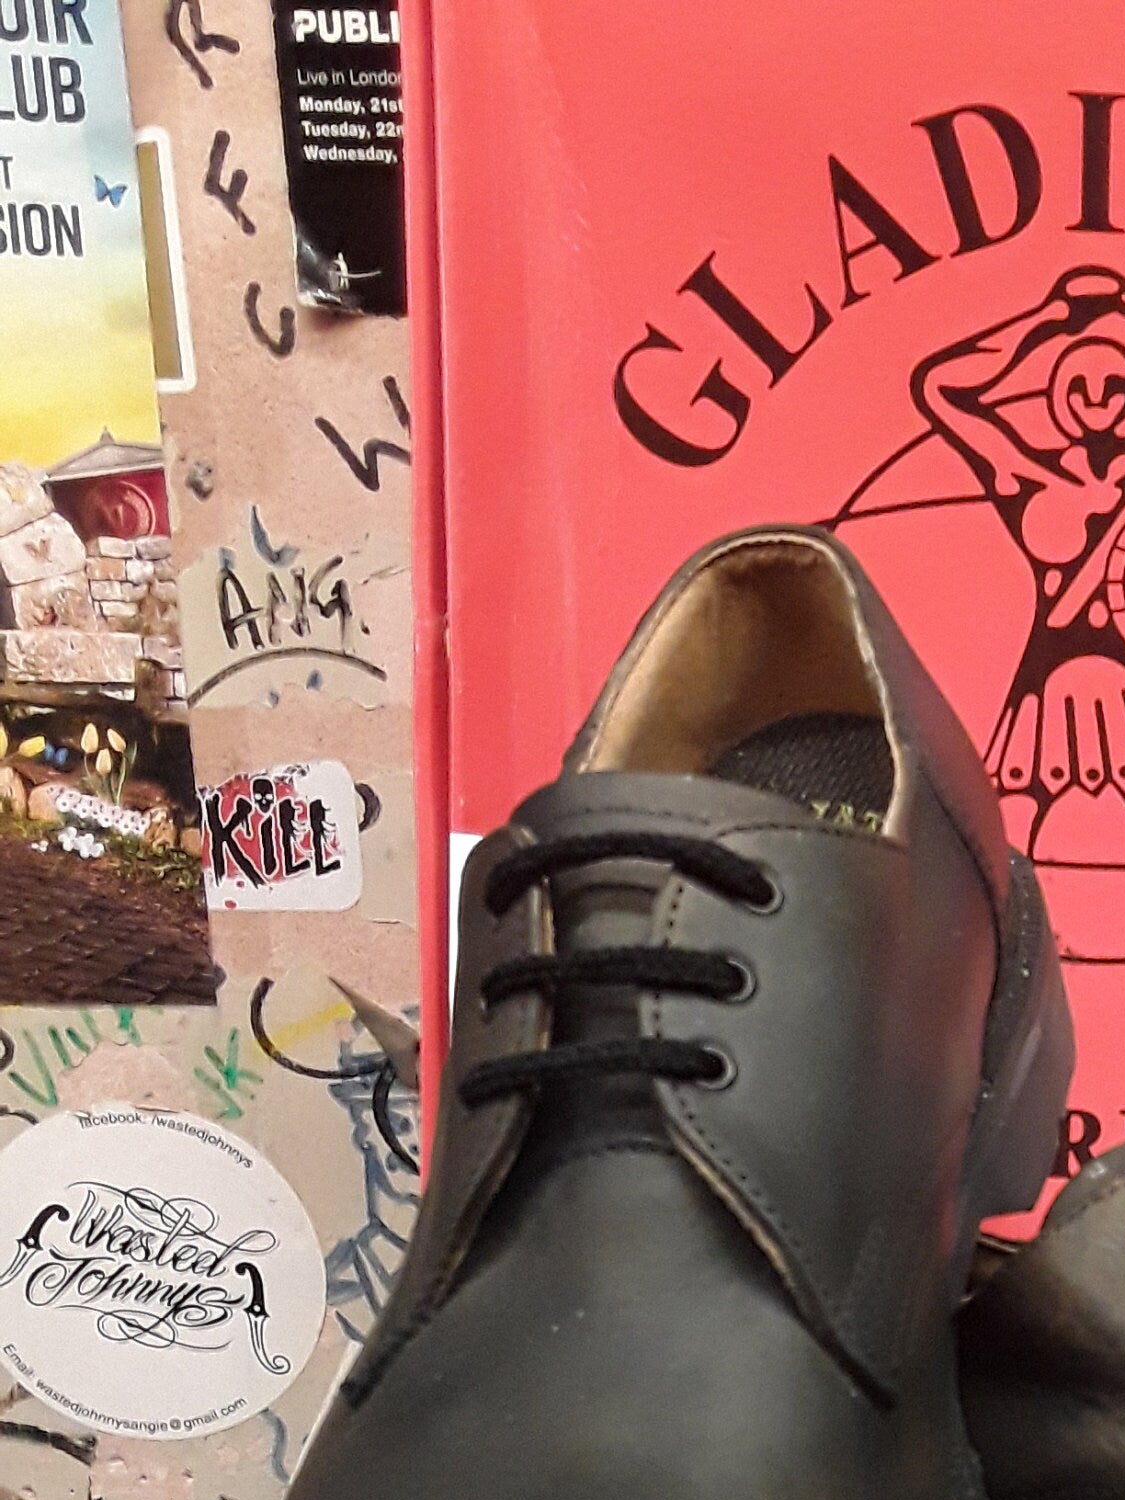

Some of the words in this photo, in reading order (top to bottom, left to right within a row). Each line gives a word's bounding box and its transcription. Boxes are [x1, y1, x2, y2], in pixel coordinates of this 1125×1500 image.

[297, 69, 329, 85] Live
[332, 69, 345, 85] in
[299, 96, 366, 115] Monday,
[301, 120, 371, 139] Tuesday,
[303, 144, 398, 164] Wednesday,
[70, 1189, 278, 1279] Wasted
[26, 1247, 245, 1328] Johnnys
